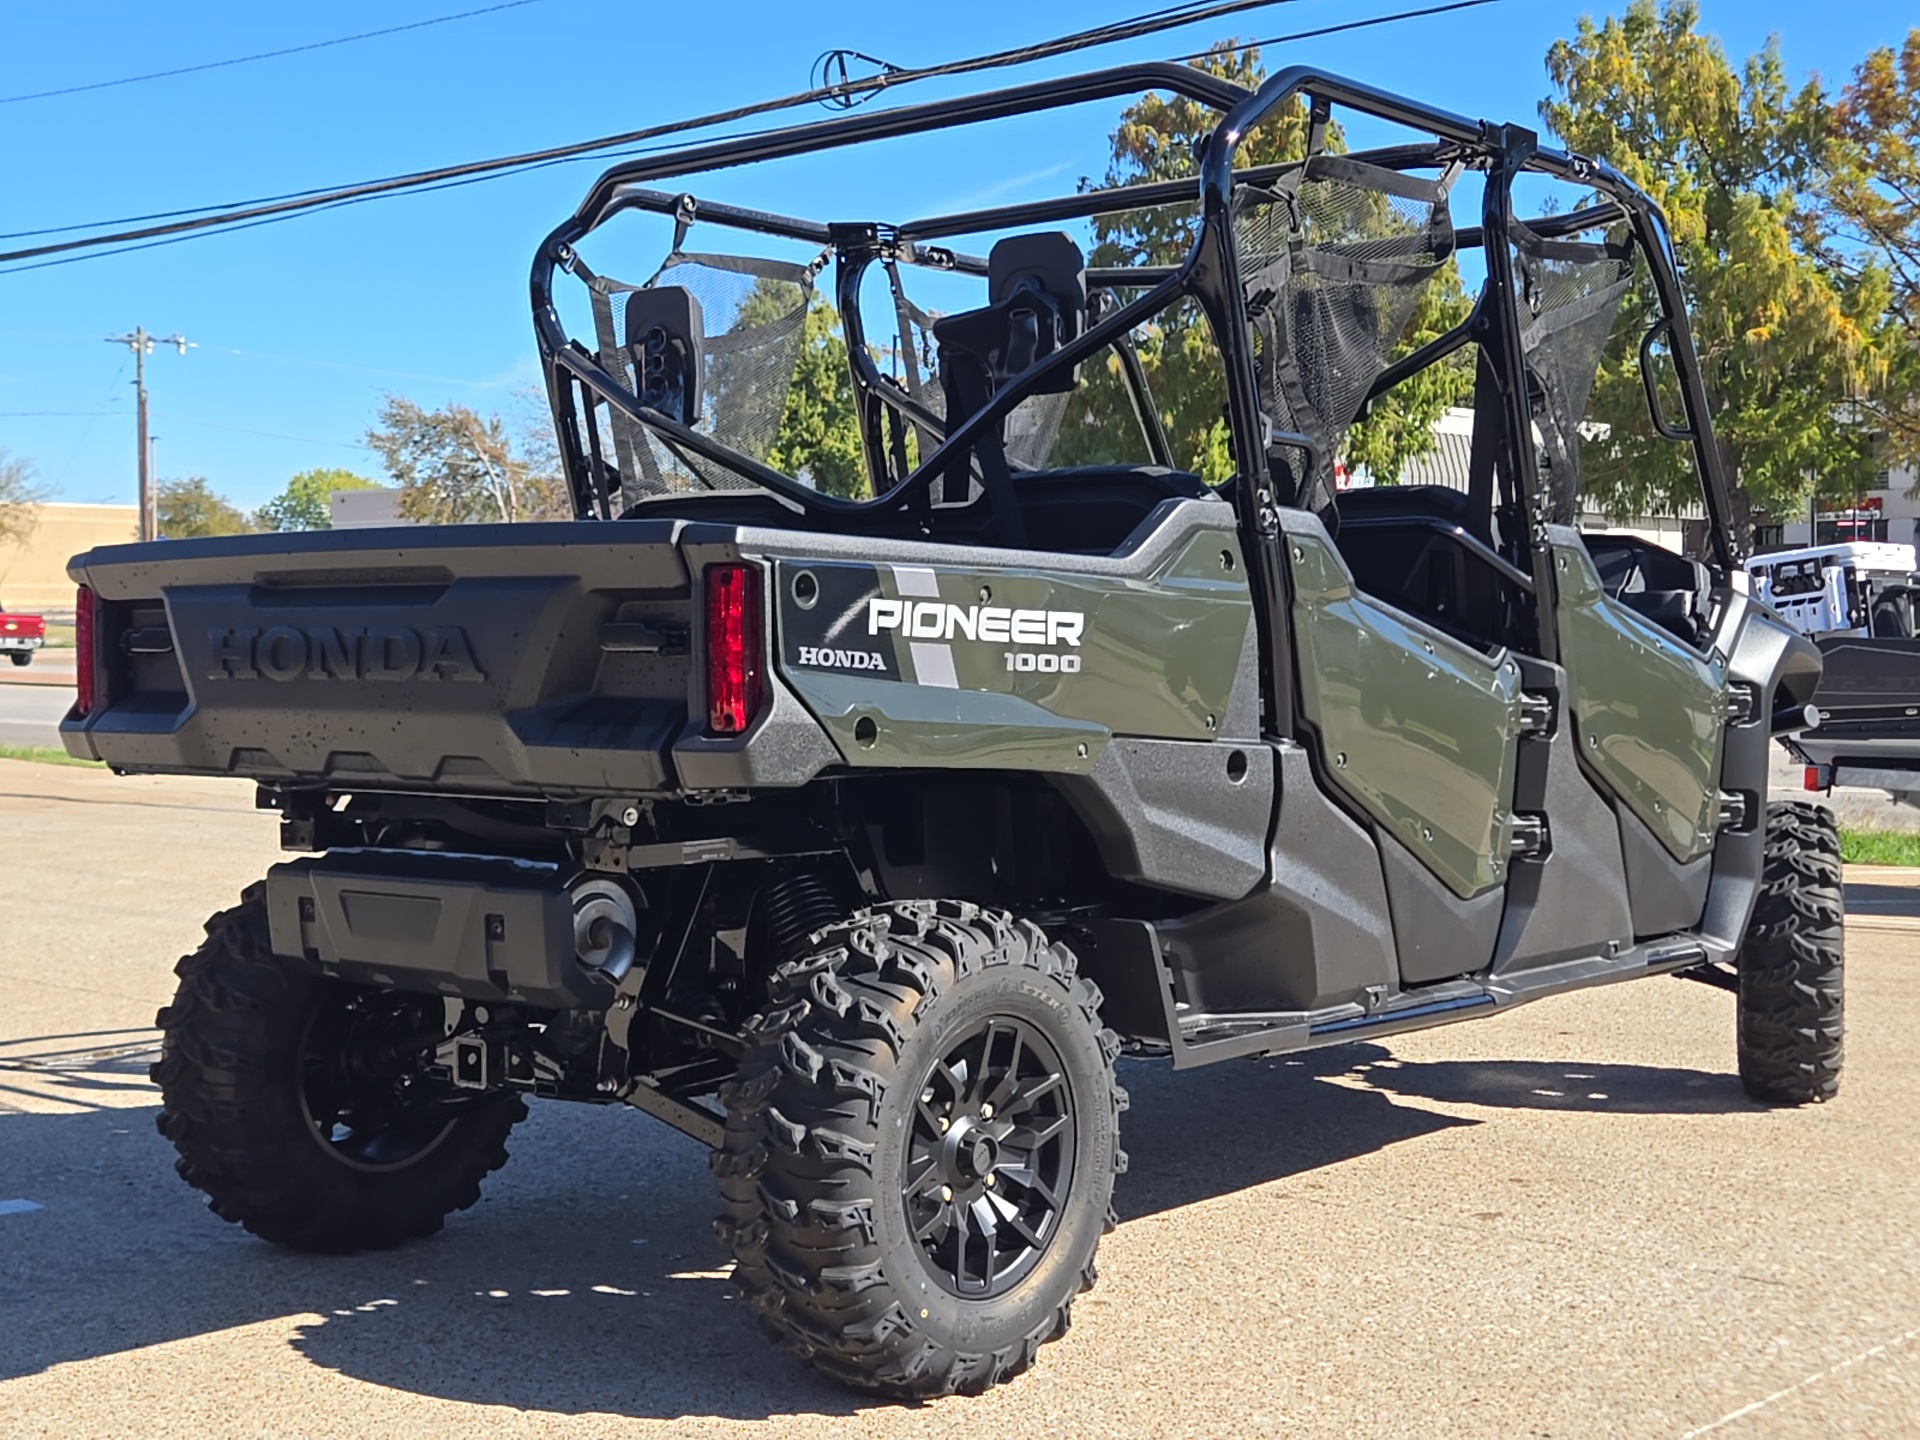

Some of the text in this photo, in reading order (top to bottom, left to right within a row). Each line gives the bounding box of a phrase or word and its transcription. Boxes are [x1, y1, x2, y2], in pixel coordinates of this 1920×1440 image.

[868, 598, 1085, 647] PIONEER
[207, 624, 489, 684] HONDA
[798, 645, 887, 672] HONDA
[1003, 652, 1082, 674] 1000
